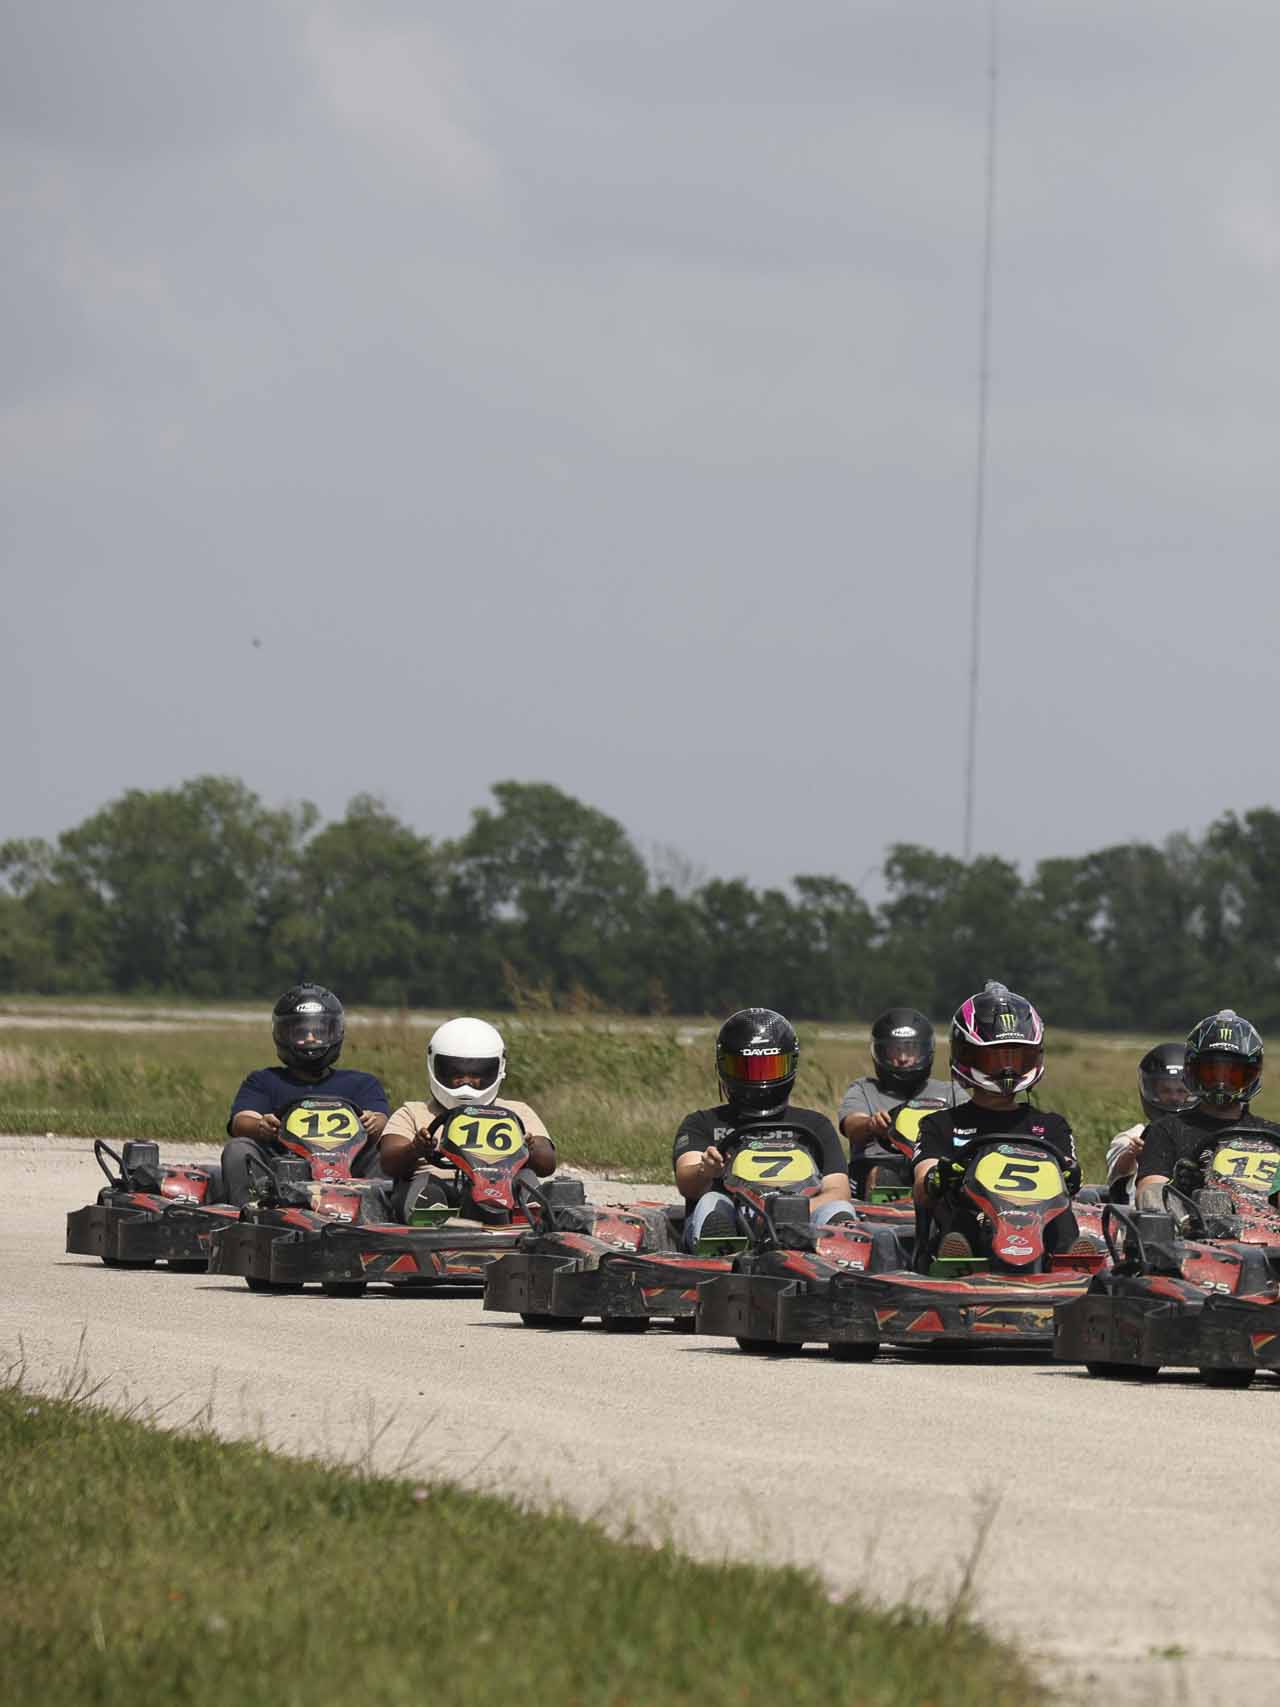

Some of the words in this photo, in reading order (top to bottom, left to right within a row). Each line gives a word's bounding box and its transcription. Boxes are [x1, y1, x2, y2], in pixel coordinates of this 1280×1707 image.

[742, 1048, 781, 1056] DAYCO
[299, 1112, 352, 1139] 12
[458, 1121, 513, 1152] 16
[751, 1156, 794, 1179] 7
[994, 1163, 1040, 1192] 5
[1227, 1156, 1280, 1183] 15
